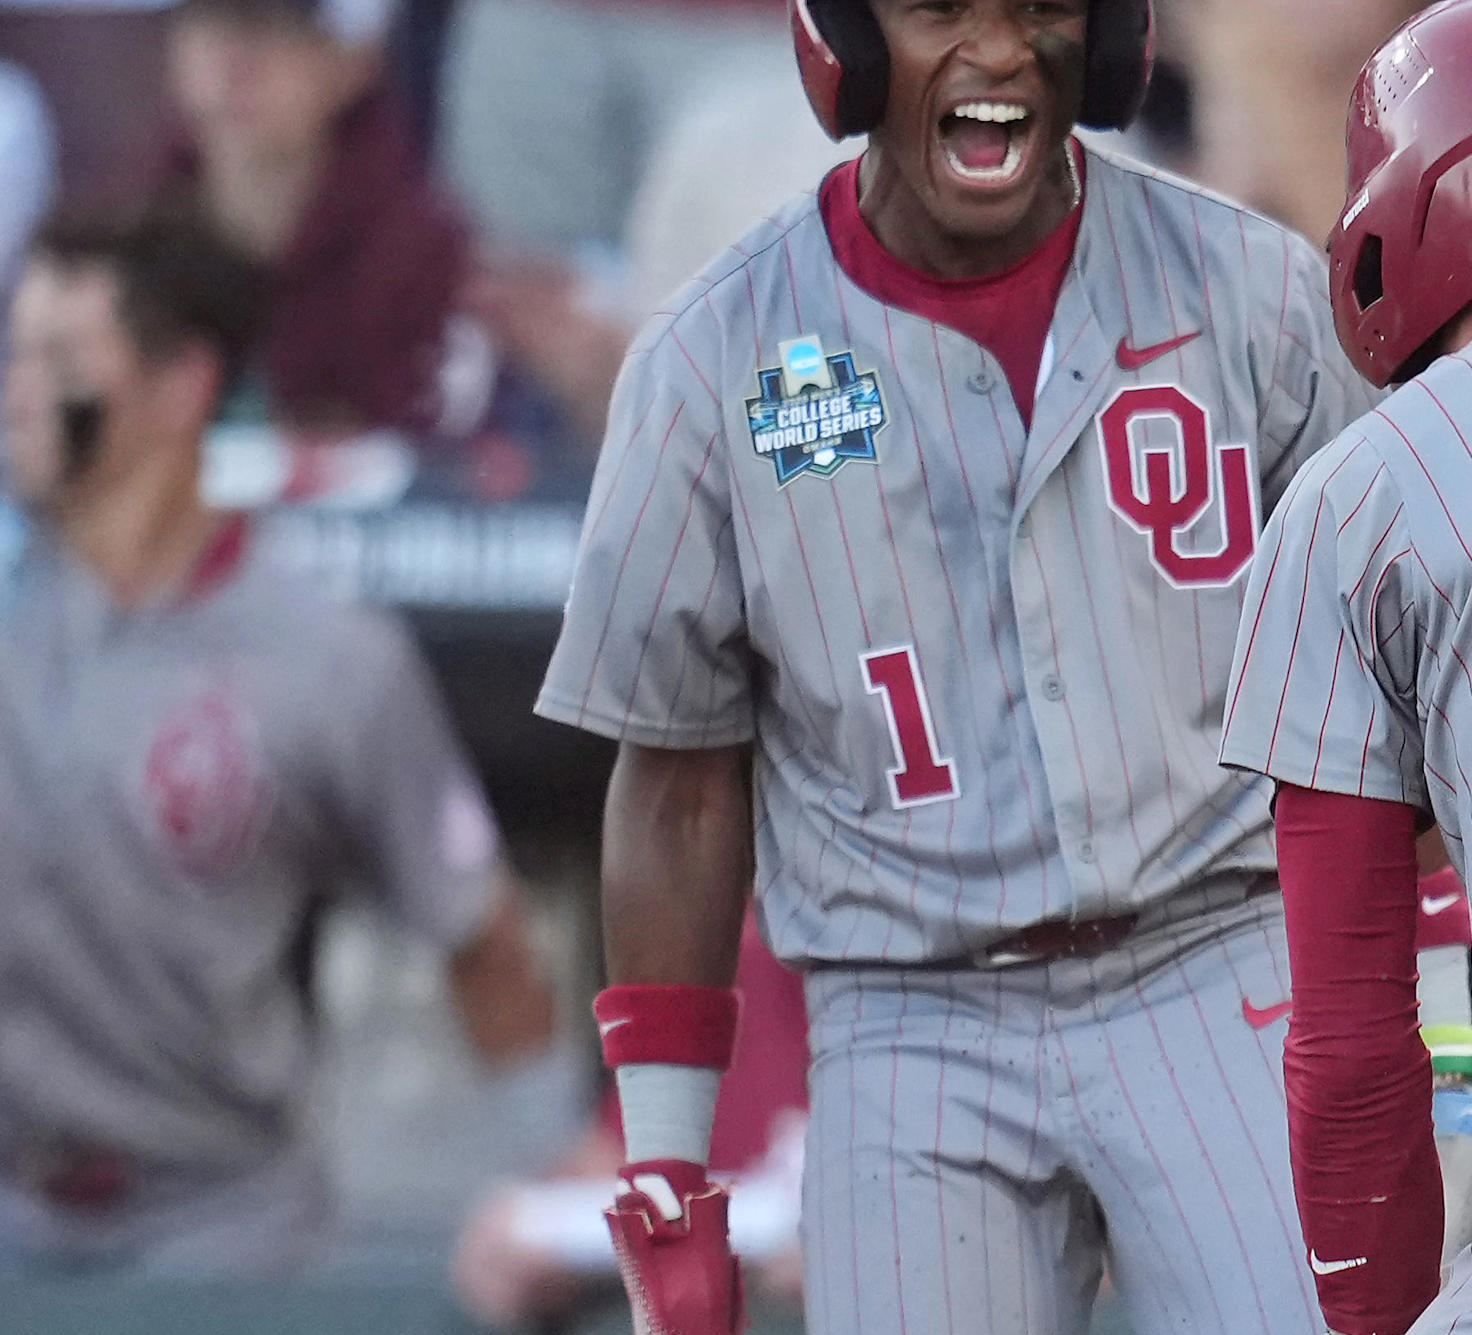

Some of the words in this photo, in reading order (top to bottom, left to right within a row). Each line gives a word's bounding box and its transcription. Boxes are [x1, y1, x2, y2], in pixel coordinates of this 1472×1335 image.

[754, 421, 819, 454] WORLD
[819, 406, 883, 439] SERIES
[777, 395, 853, 429] COLLEGE
[1093, 382, 1258, 590] OU
[857, 643, 961, 811] 1
